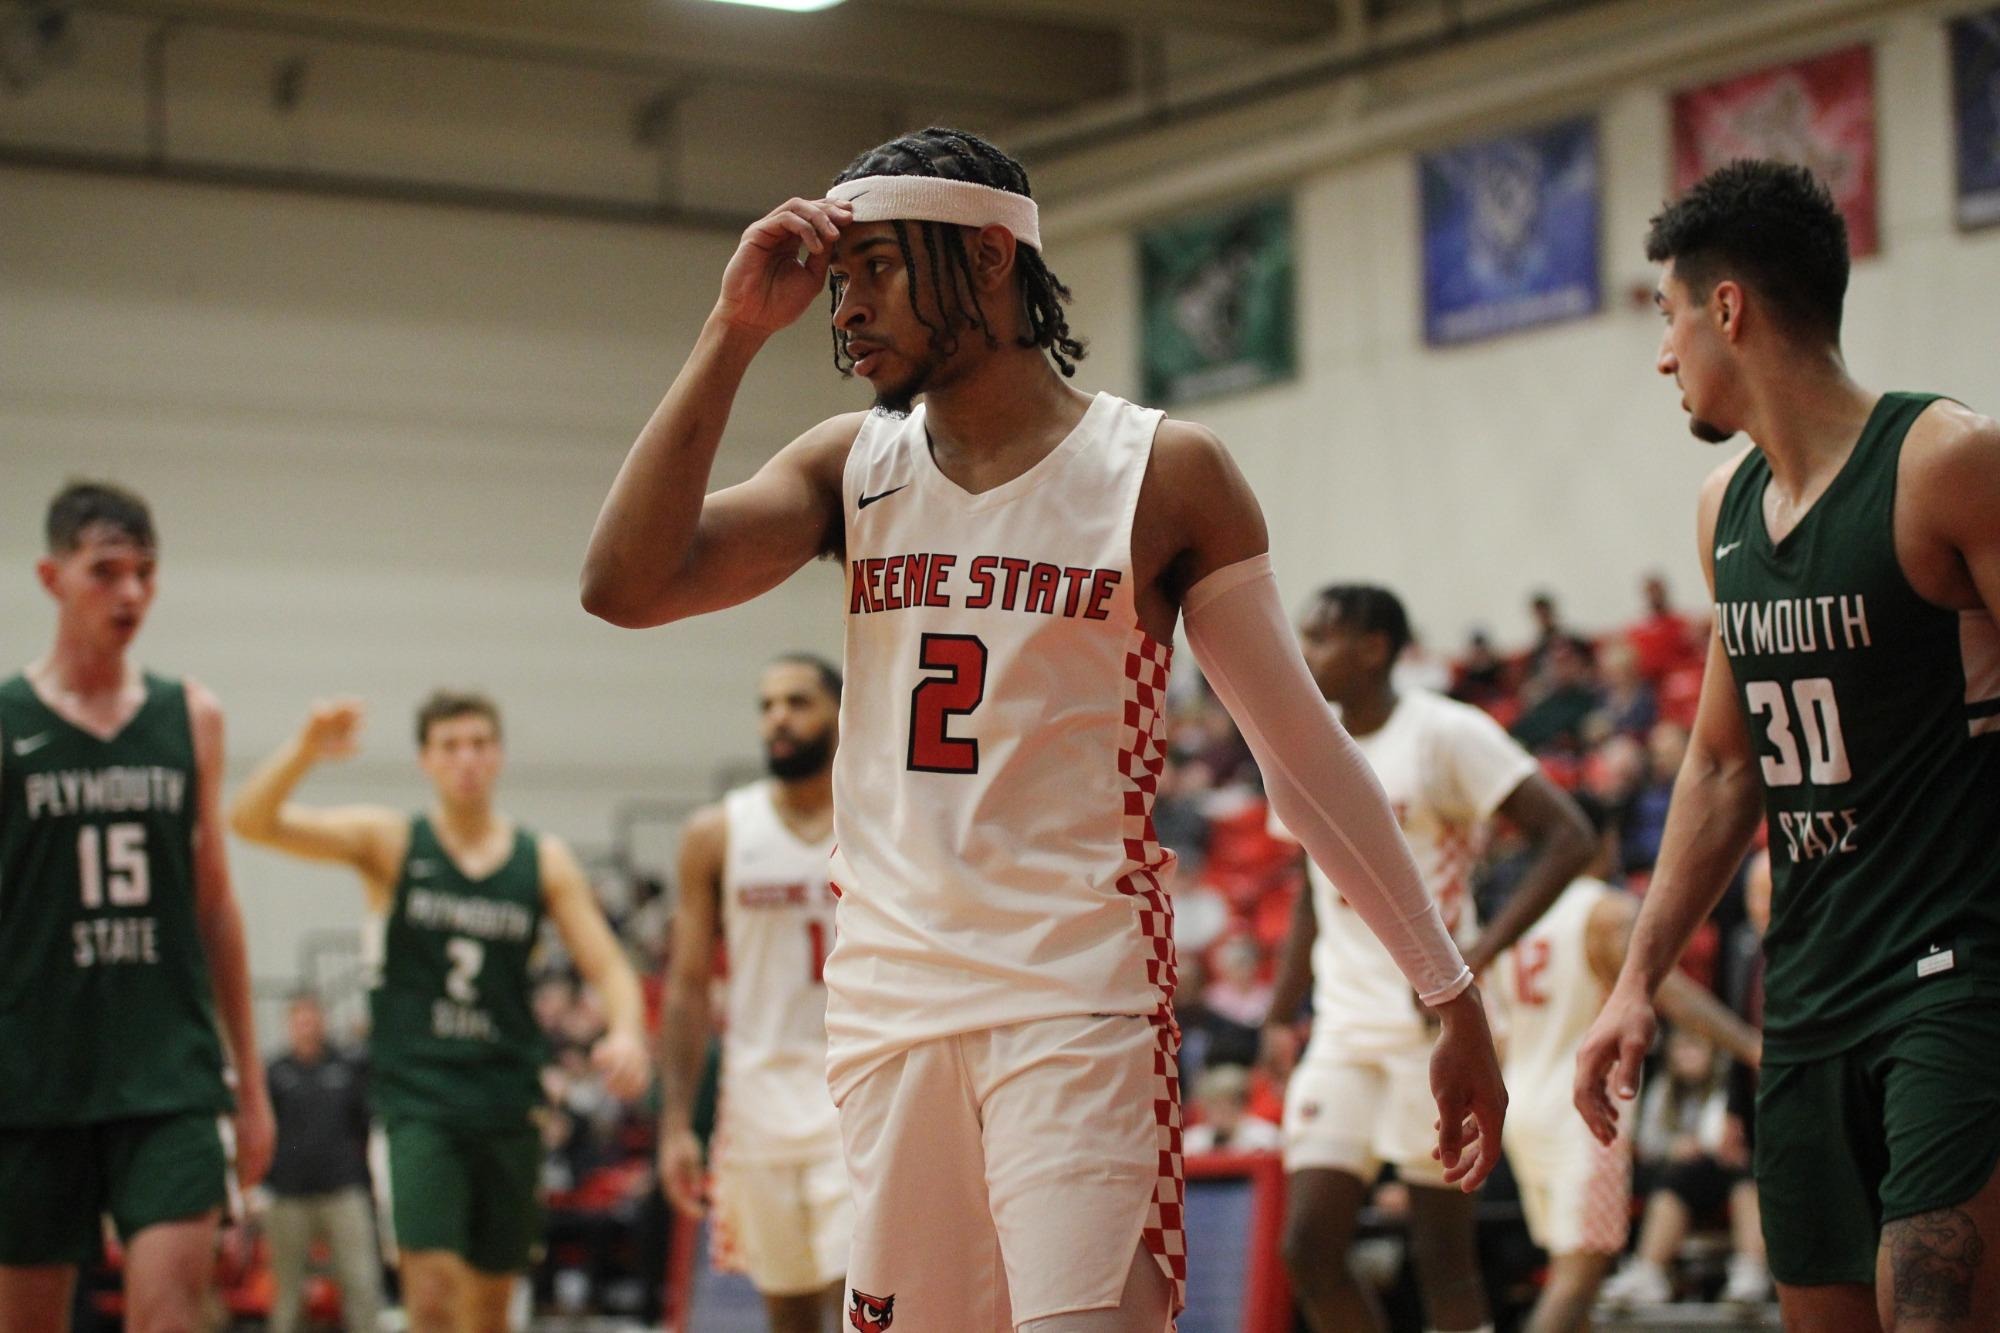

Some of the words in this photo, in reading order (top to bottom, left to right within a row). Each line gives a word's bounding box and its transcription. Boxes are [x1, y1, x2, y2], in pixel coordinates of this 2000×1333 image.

[850, 553, 957, 614] KEENE
[965, 555, 1122, 621] STATE
[906, 632, 988, 774] 2
[1745, 677, 1852, 787] 30
[26, 766, 184, 819] PLYMOUTH
[77, 822, 149, 908] 15
[1778, 808, 1858, 863] STATE
[72, 917, 159, 967] STATE
[446, 937, 485, 1003] 2
